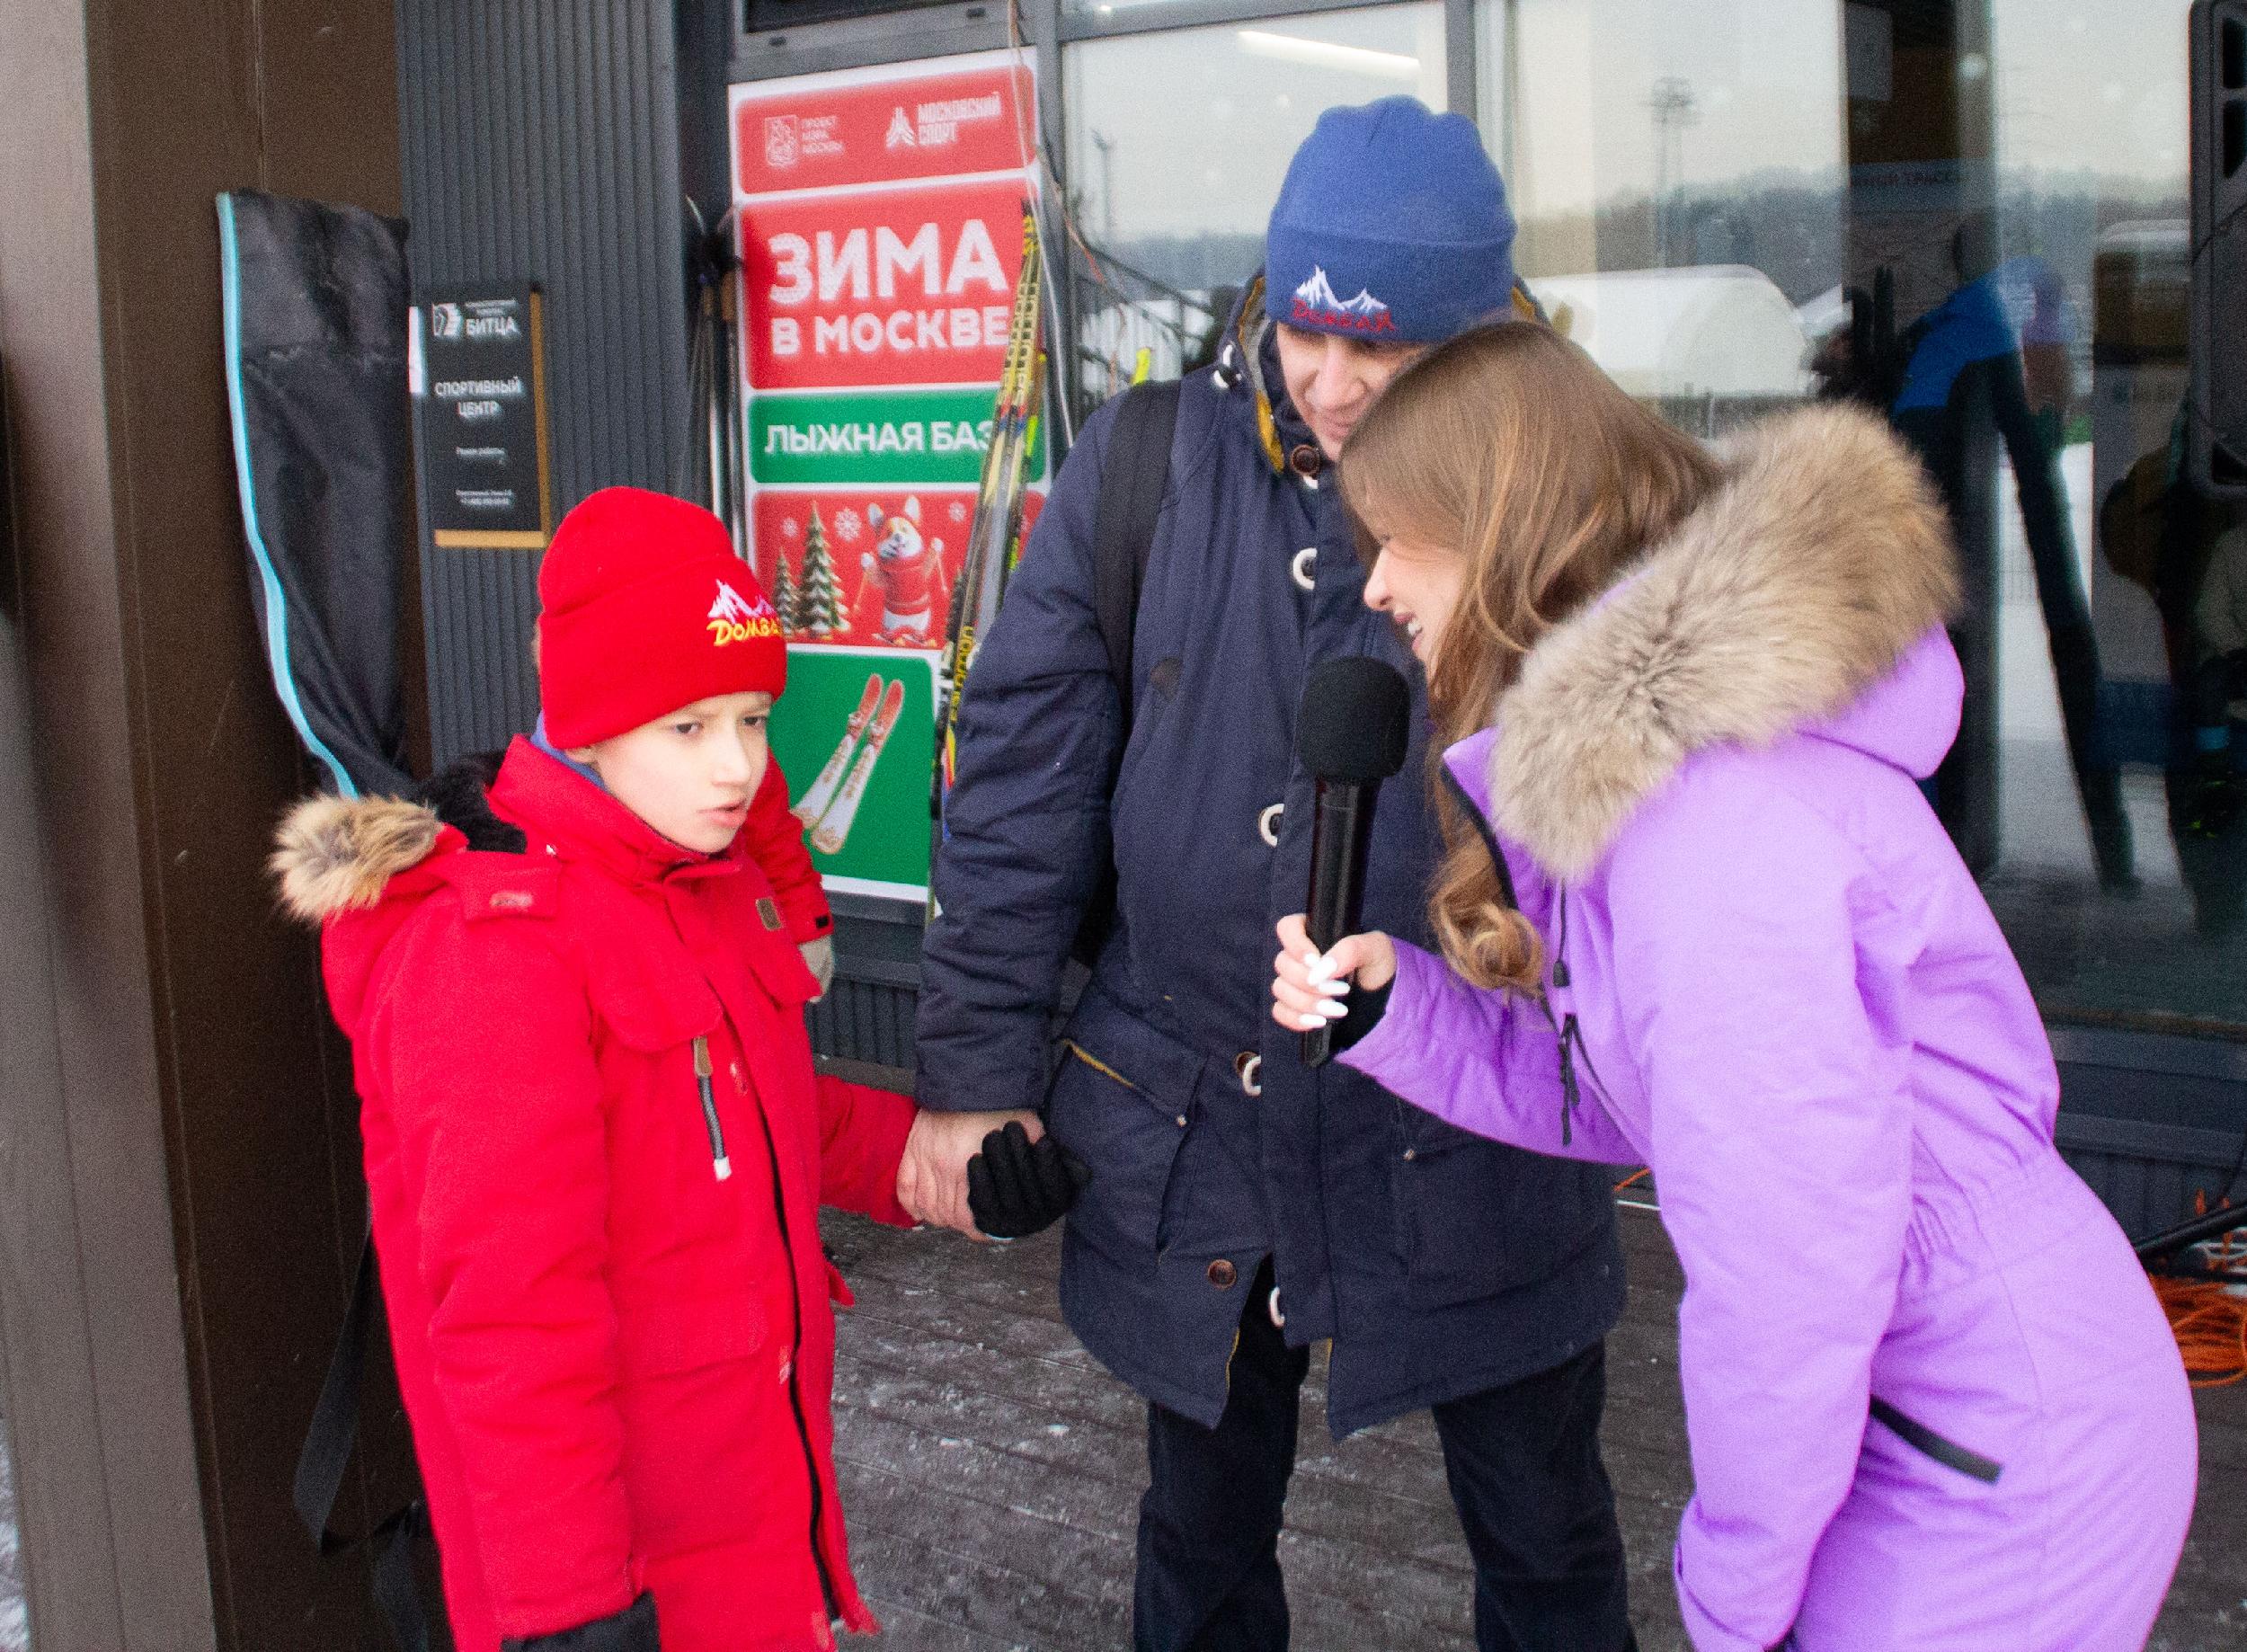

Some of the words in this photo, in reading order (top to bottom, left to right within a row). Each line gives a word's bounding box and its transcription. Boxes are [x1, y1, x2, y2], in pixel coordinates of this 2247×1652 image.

[768, 219, 1009, 304] ЗИМА
[466, 316, 518, 336] БИТЦА
[770, 317, 801, 355] В
[814, 306, 1009, 354] МОСКВЕ
[434, 377, 521, 396] СПОРТИВНЫЙ
[457, 401, 500, 417] ЦЕНТР
[765, 422, 925, 454] ЛЫЖНАЯ
[931, 421, 994, 451] БАЗ
